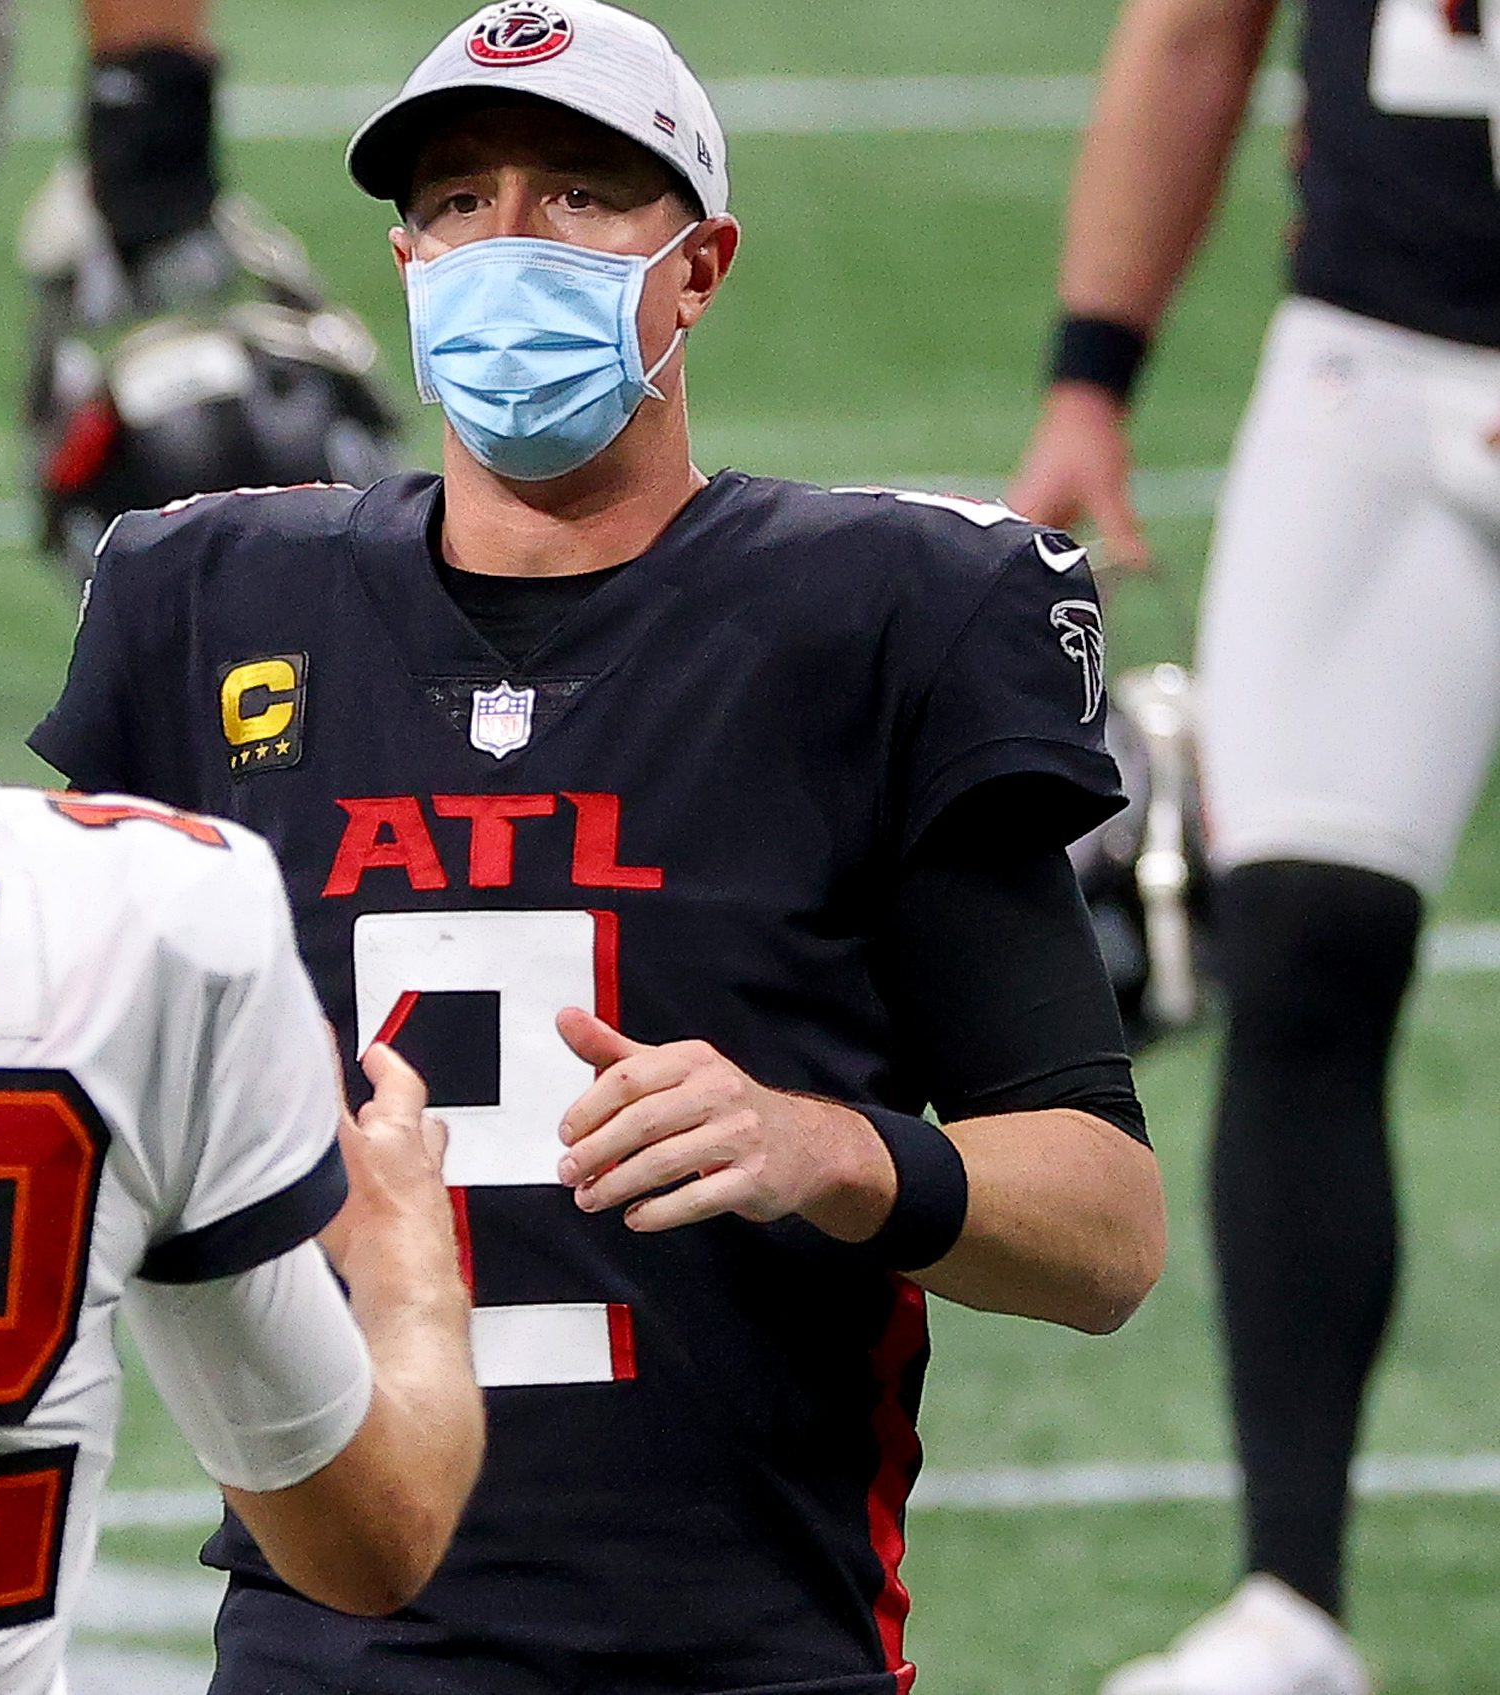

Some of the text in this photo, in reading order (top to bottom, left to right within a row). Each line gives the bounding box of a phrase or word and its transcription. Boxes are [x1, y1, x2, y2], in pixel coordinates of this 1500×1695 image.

[220, 659, 298, 746] C
[321, 791, 665, 898] ATL
[353, 909, 638, 1388] 2
